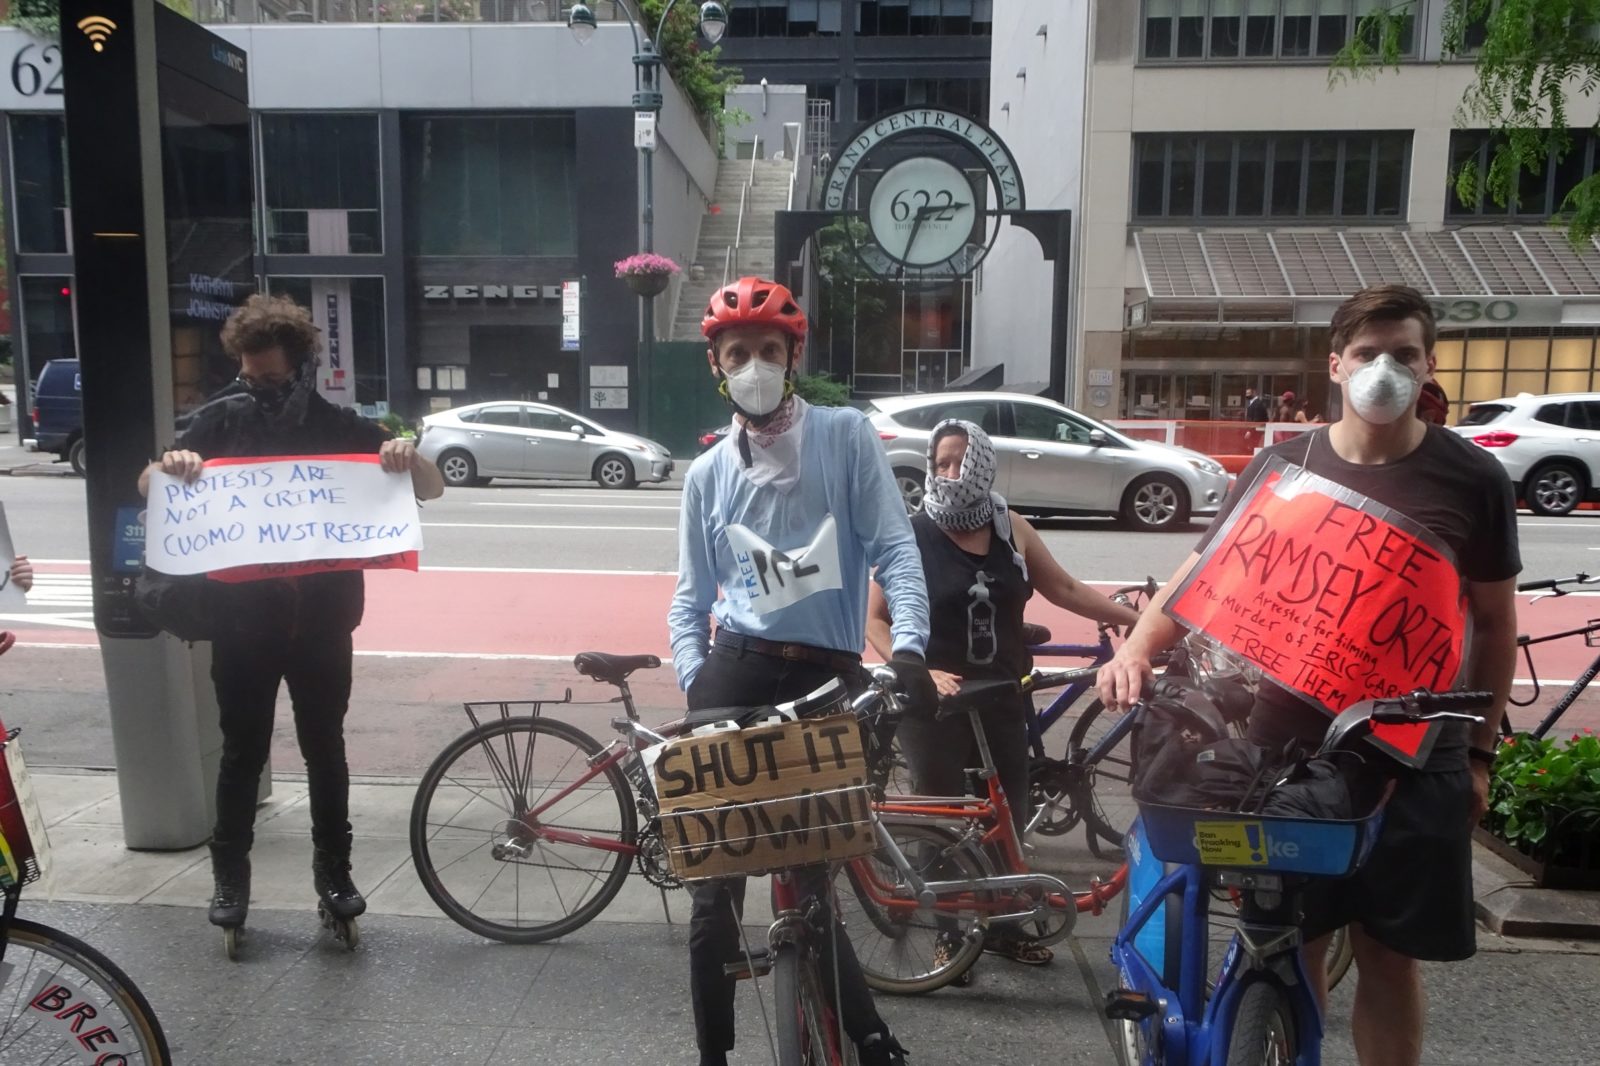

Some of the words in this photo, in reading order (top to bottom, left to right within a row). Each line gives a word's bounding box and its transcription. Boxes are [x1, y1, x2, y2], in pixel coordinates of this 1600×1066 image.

[828, 136, 870, 209] GRAND
[874, 111, 974, 139] CENTRAL
[979, 135, 1019, 207] PLAZA
[890, 189, 954, 222] 622
[164, 500, 211, 525] NOT
[228, 495, 247, 512] A
[264, 487, 347, 509] CRIME
[165, 467, 274, 504] PROTESTS
[289, 464, 336, 482] ARE
[163, 521, 245, 557] CUOMO
[324, 522, 410, 544] RESIGN
[737, 550, 760, 600] FREE
[1314, 500, 1440, 588] FREE
[1195, 579, 1219, 602] The
[1221, 597, 1281, 632] Murder
[1285, 631, 1309, 650] of
[1306, 643, 1361, 682] ERIC
[1364, 670, 1402, 699] GAR
[1219, 513, 1383, 628] RAMSEY
[1369, 596, 1453, 693] ORTA
[1252, 590, 1313, 627] Arrested
[1313, 615, 1333, 639] for
[1334, 632, 1380, 677] filming
[1229, 624, 1291, 674] FREE
[1292, 659, 1347, 710] THEM
[656, 730, 785, 799] SHUT
[672, 776, 873, 868] DOWN!
